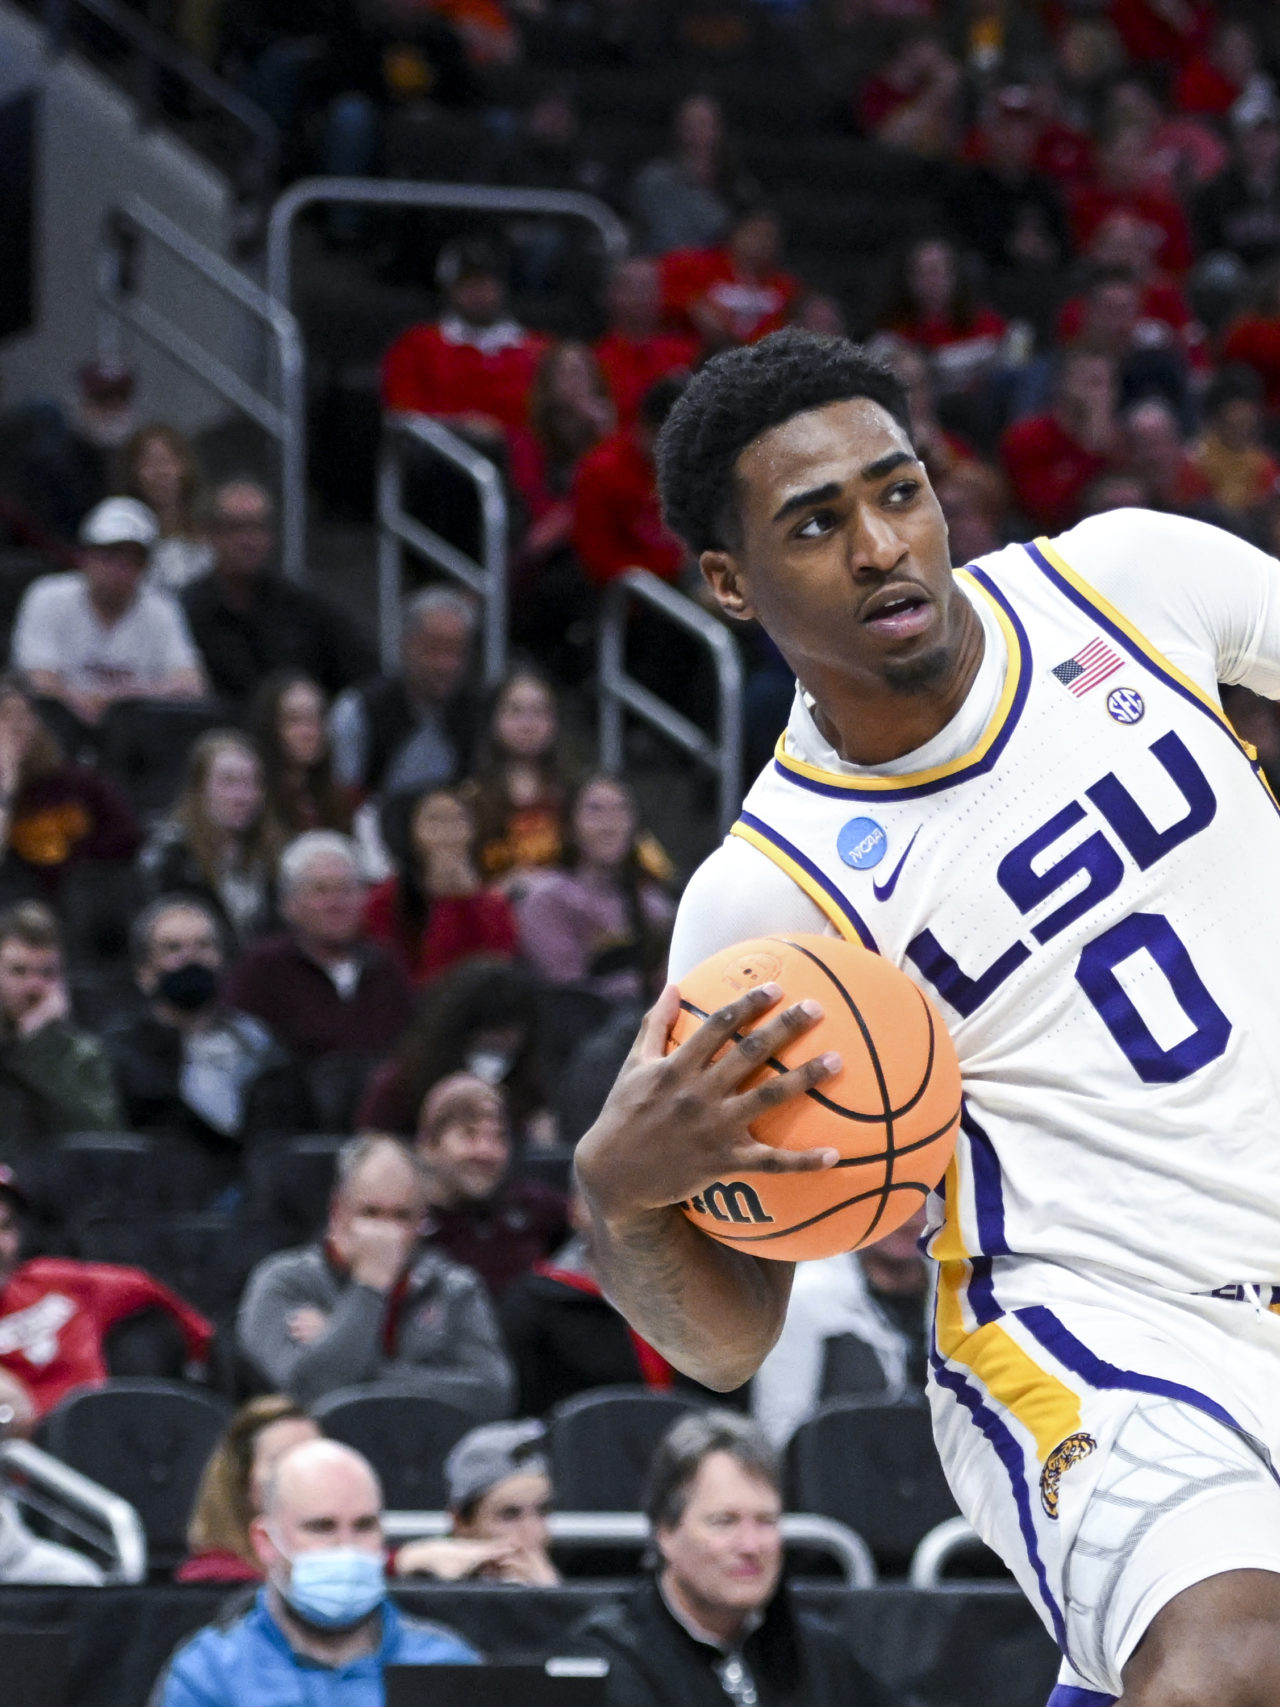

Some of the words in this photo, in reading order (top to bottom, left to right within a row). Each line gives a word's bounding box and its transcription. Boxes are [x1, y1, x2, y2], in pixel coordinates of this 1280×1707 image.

[1108, 688, 1143, 724] SEC
[848, 827, 885, 864] NCAA
[905, 730, 1217, 1019] LSU
[1075, 912, 1232, 1083] 0
